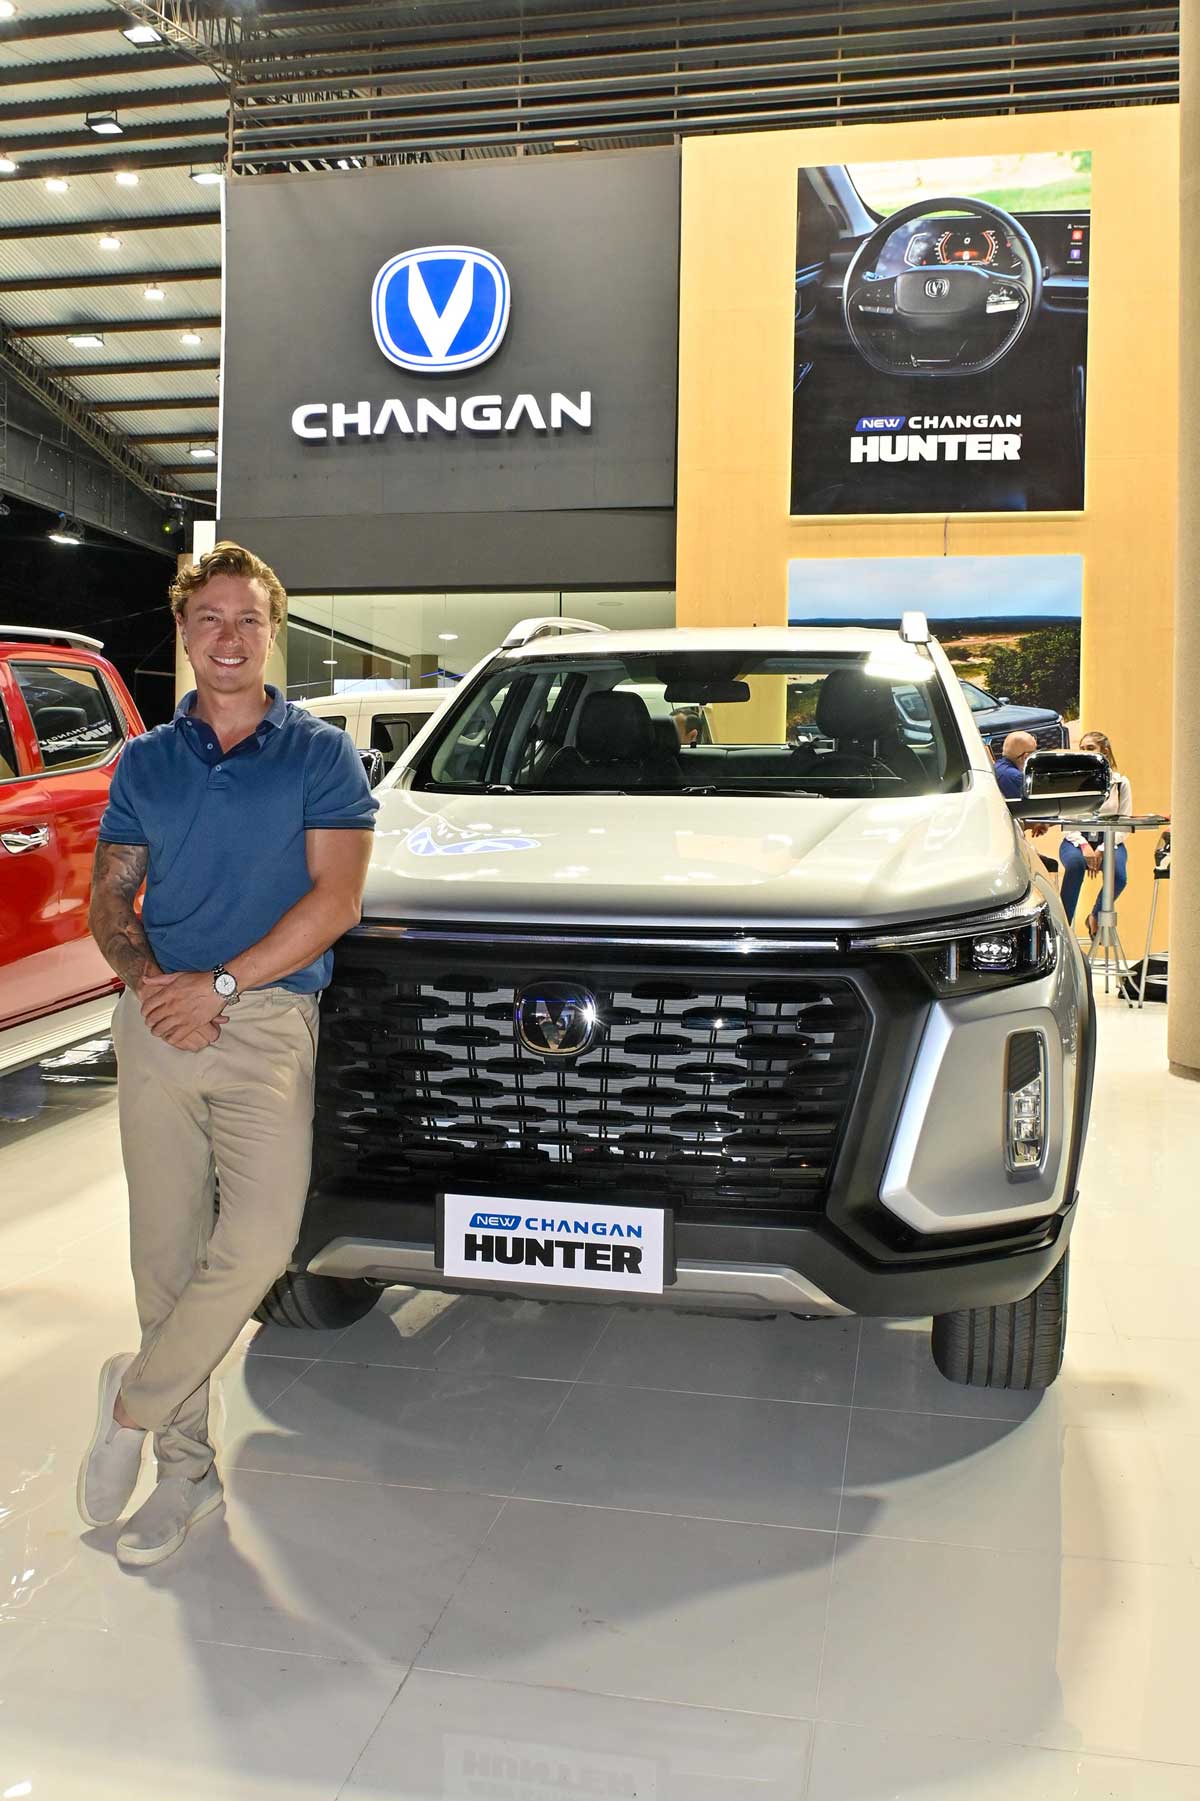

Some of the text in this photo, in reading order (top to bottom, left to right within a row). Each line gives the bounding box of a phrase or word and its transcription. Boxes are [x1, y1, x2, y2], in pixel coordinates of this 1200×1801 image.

[291, 391, 592, 439] CHANGAN
[862, 414, 1022, 430] NEW CHANGAN
[850, 433, 1022, 463] HUNTER
[476, 1215, 642, 1239] NEW CHANGAN
[464, 1233, 643, 1274] HUNTER
